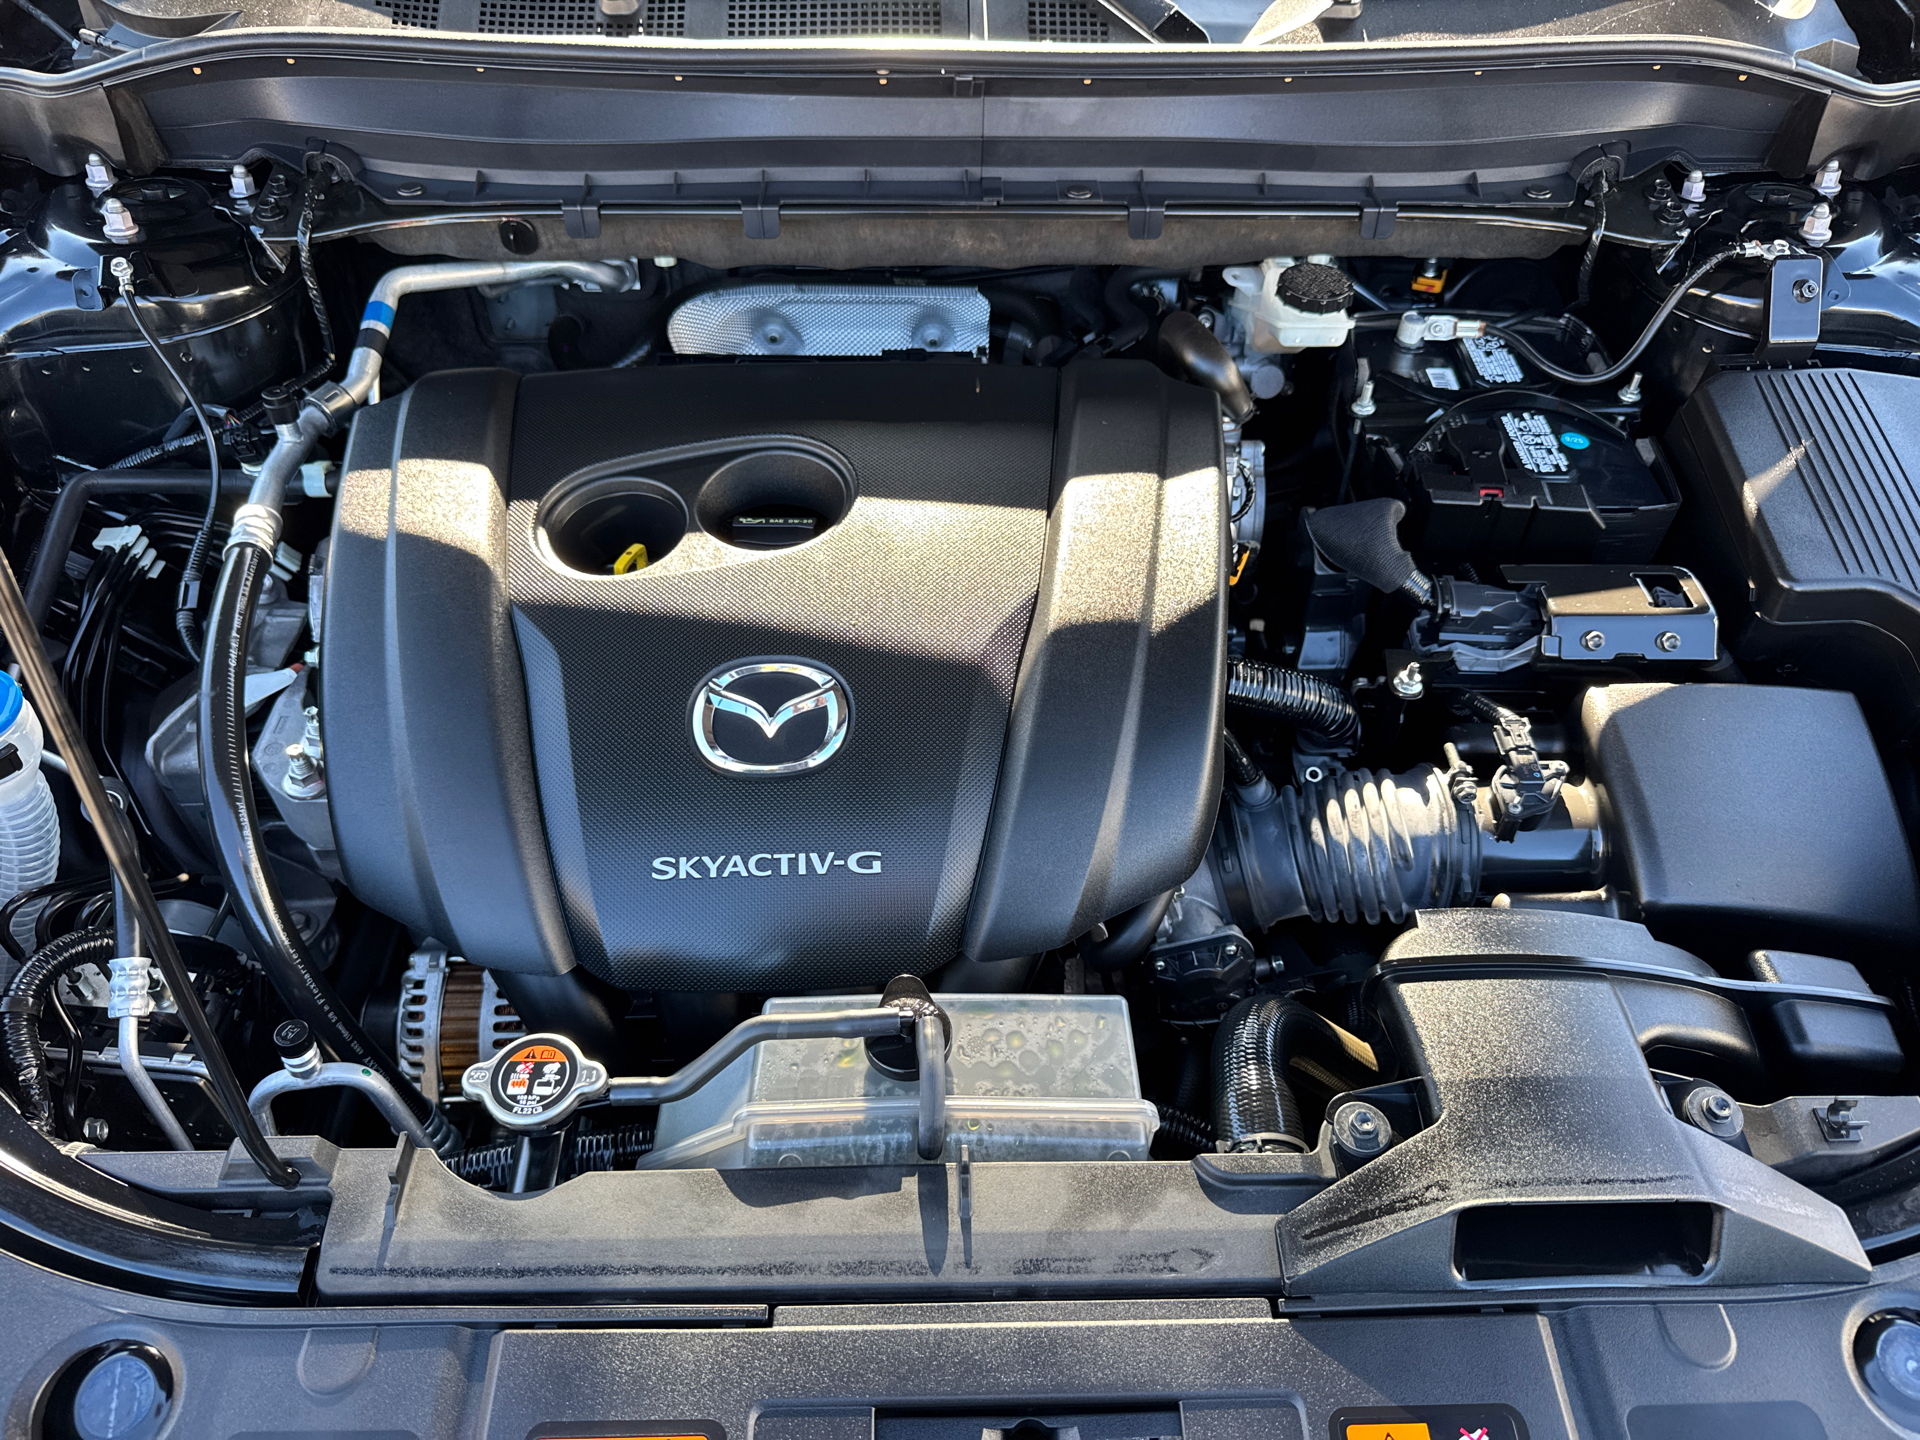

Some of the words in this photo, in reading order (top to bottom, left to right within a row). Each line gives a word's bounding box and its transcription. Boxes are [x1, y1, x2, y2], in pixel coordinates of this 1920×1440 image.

[1564, 436, 1584, 444] 9/25
[651, 851, 882, 880] SKYACTIV-G
[288, 947, 326, 1005] Flexbarrier
[581, 1069, 597, 1082] 1.1
[513, 1106, 532, 1114] FL22
